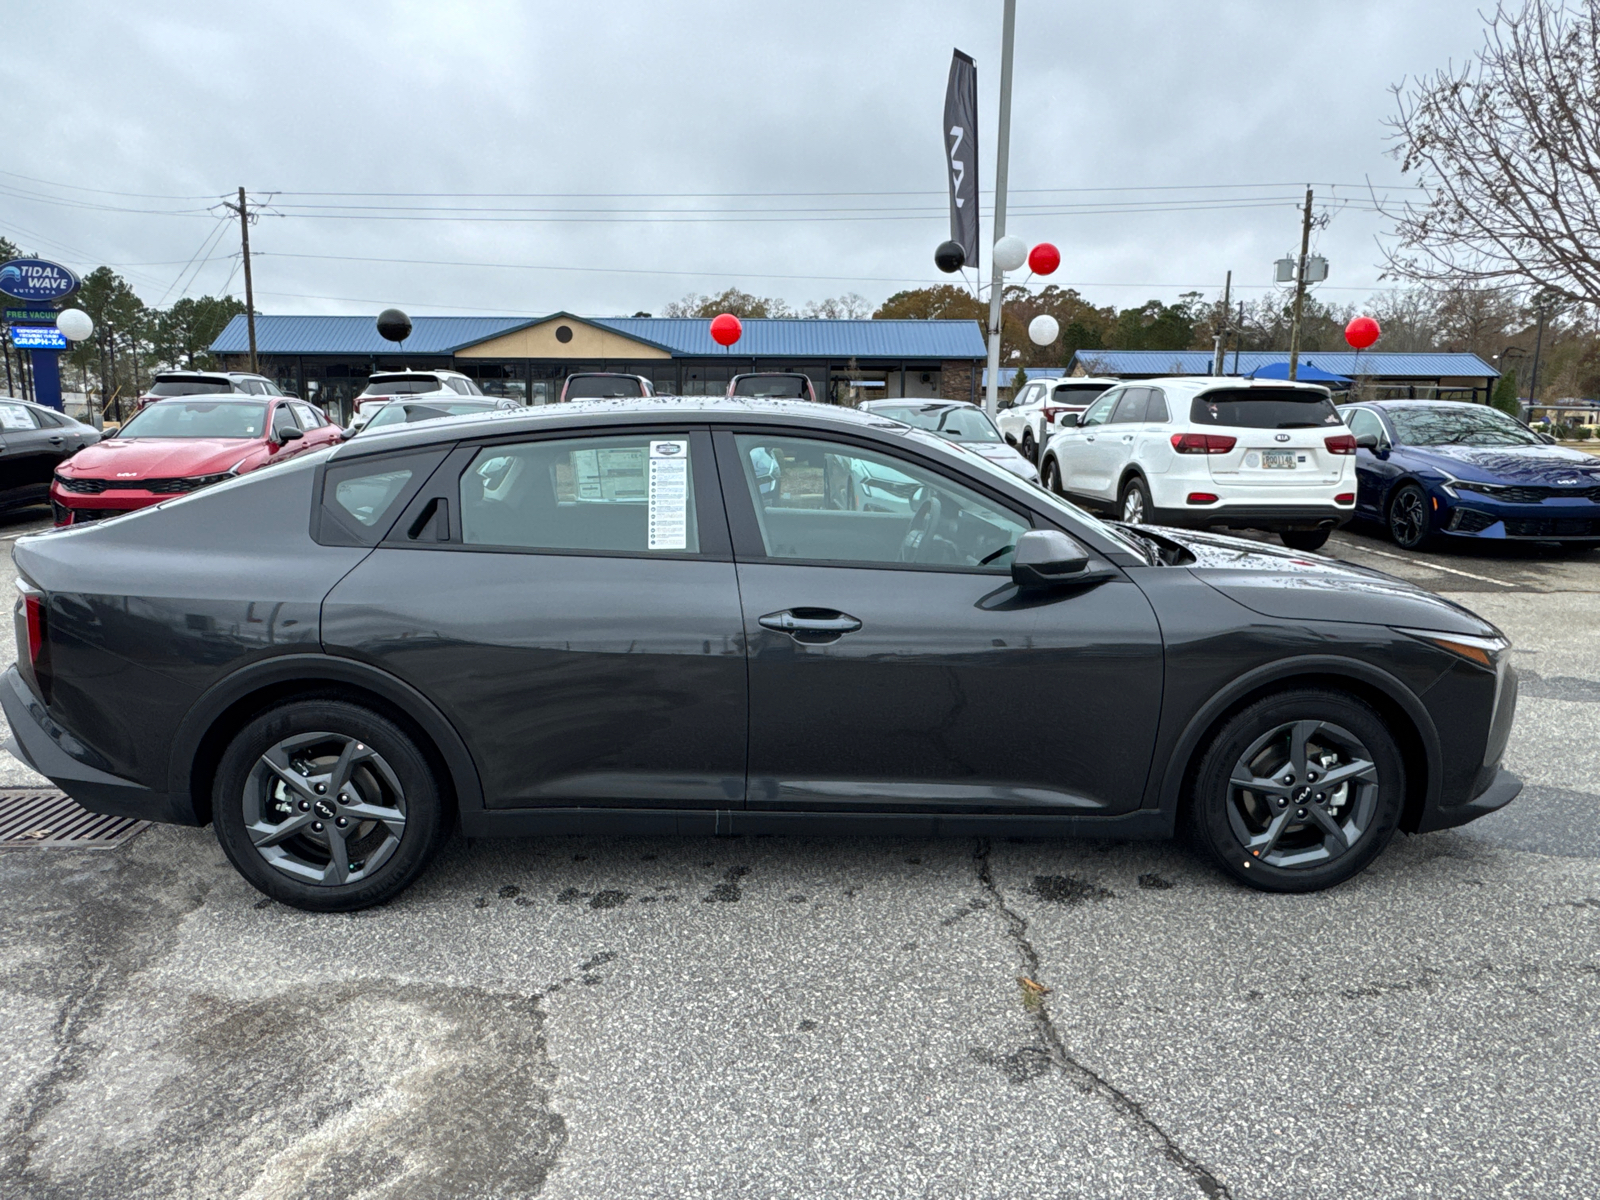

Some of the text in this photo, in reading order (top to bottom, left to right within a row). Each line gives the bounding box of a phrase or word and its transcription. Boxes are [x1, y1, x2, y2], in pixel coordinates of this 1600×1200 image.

[21, 266, 59, 277] TIDAL
[28, 278, 68, 289] WAVE
[29, 311, 58, 319] VACUU
